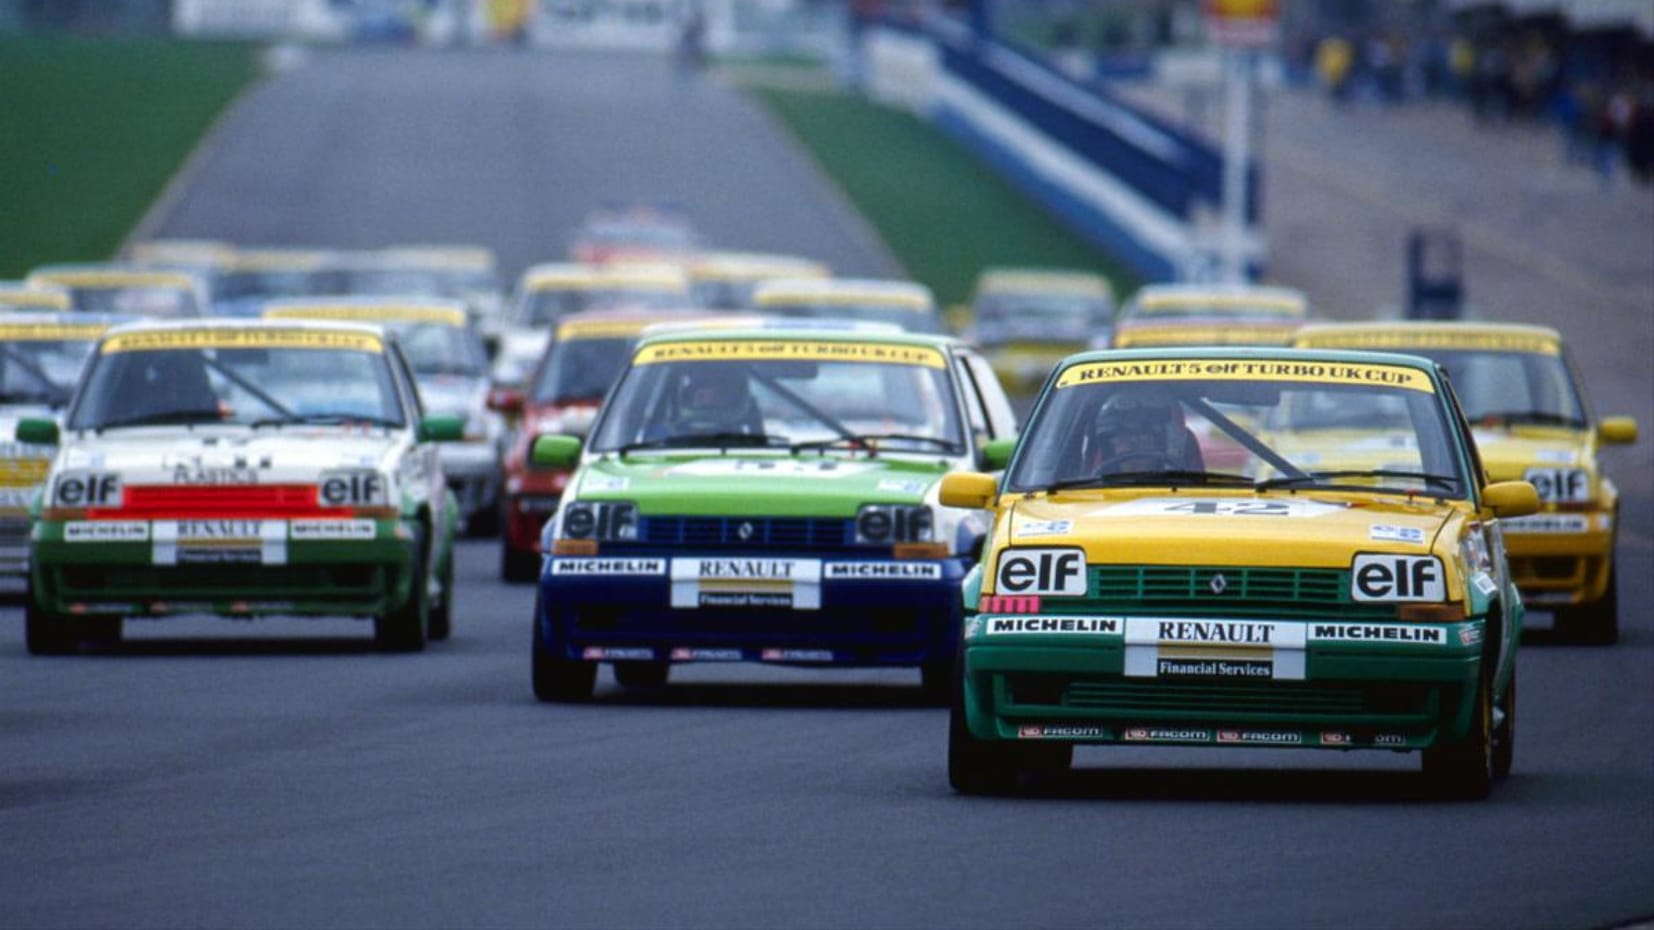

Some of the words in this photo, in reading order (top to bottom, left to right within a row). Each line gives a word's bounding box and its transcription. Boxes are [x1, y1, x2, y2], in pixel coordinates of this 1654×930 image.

[1079, 362, 1188, 381] RENAULT
[1189, 362, 1202, 375] 5
[1205, 362, 1241, 375] elf
[1243, 362, 1326, 377] TURBO
[1329, 365, 1363, 380] UK
[1364, 368, 1413, 384] CUP
[59, 472, 118, 504] elf
[321, 473, 381, 505] elf
[1164, 501, 1292, 516] 42
[565, 503, 635, 540] elf
[858, 505, 934, 542] elf
[558, 560, 660, 574] MICHELIN
[699, 560, 795, 578] RENAULT
[831, 563, 936, 577] MICHELIN
[1000, 552, 1080, 592] elf
[1356, 558, 1437, 597] elf
[993, 618, 1118, 633] MICHELIN
[1157, 620, 1275, 643] RENAULT
[1314, 625, 1441, 642] MICHELIN
[1159, 661, 1216, 675] Financial
[1219, 662, 1271, 676] Services
